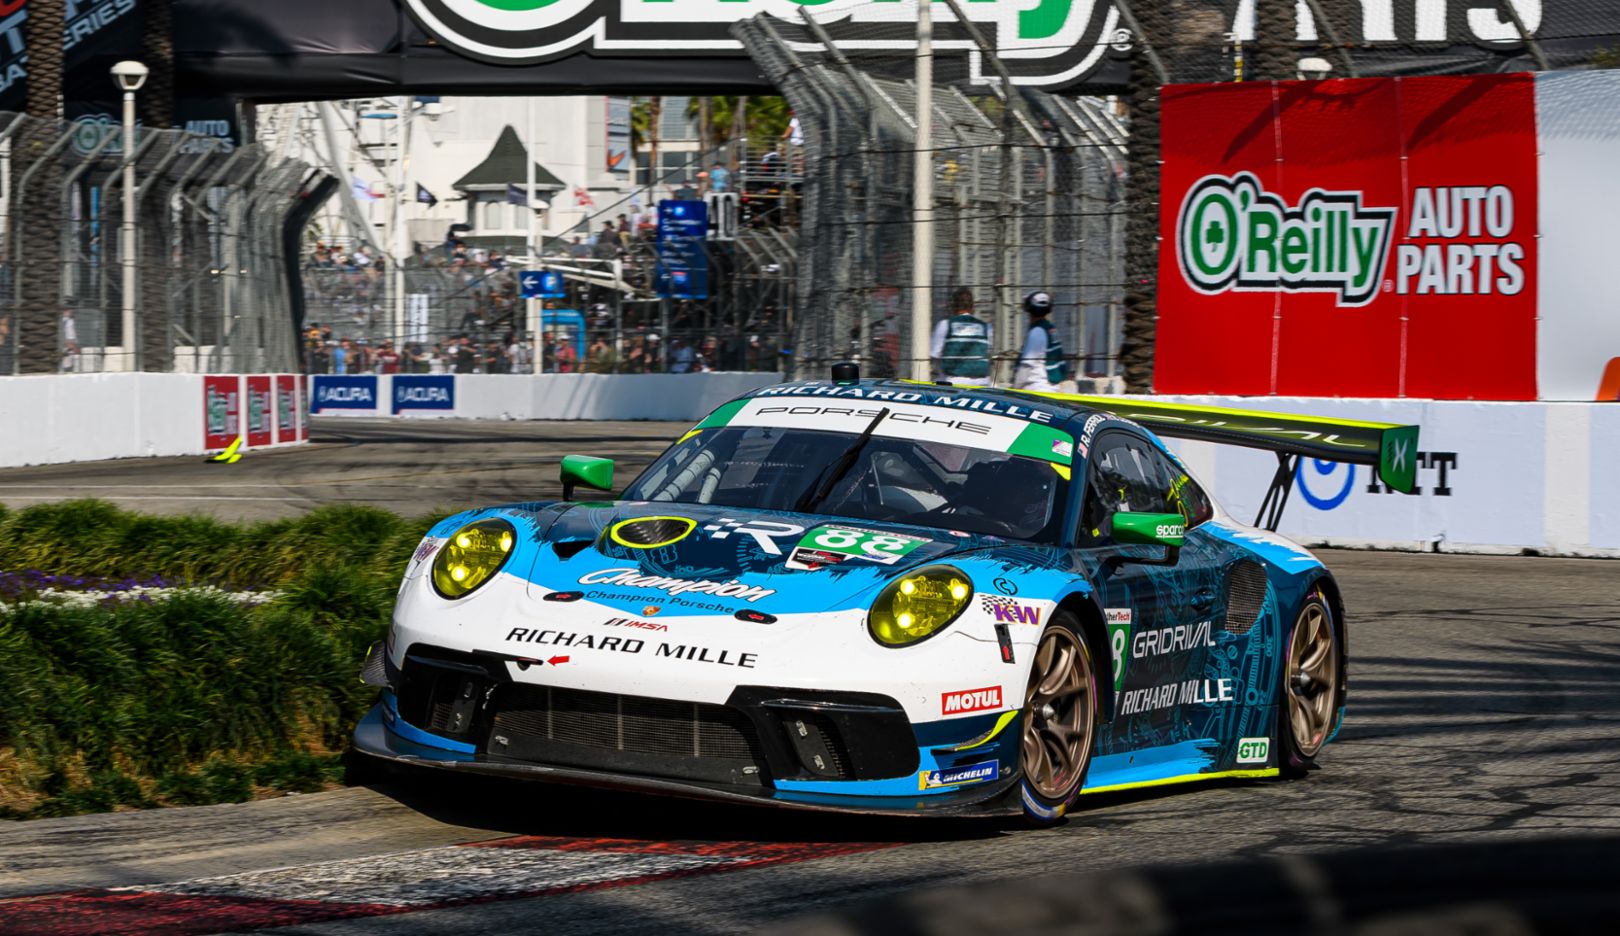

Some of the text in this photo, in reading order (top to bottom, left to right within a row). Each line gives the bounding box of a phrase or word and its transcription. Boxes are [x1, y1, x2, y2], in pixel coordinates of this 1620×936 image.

[62, 0, 137, 51] ERIES
[1409, 185, 1514, 238] AUTO
[1184, 182, 1388, 297] O'Reilly
[1396, 243, 1524, 296] PARTS
[326, 386, 373, 402] ACURA
[404, 386, 450, 402] ACURA
[756, 385, 1054, 424] RICHARD MILLE
[755, 406, 993, 436] PORSCHE
[814, 529, 912, 558] 88
[1155, 524, 1184, 539] sparc
[577, 568, 778, 602] Champion
[585, 590, 735, 614] Champion Porsche
[993, 603, 1041, 626] KW
[505, 627, 758, 669] RICHARD MILLE
[1132, 620, 1216, 659] GRIDRIVAL
[944, 688, 1001, 712] MOTUL
[1120, 683, 1178, 715] RICHARD
[1177, 678, 1233, 705] MILLE
[1239, 741, 1268, 759] GTD
[942, 767, 993, 783] MICHELIN
